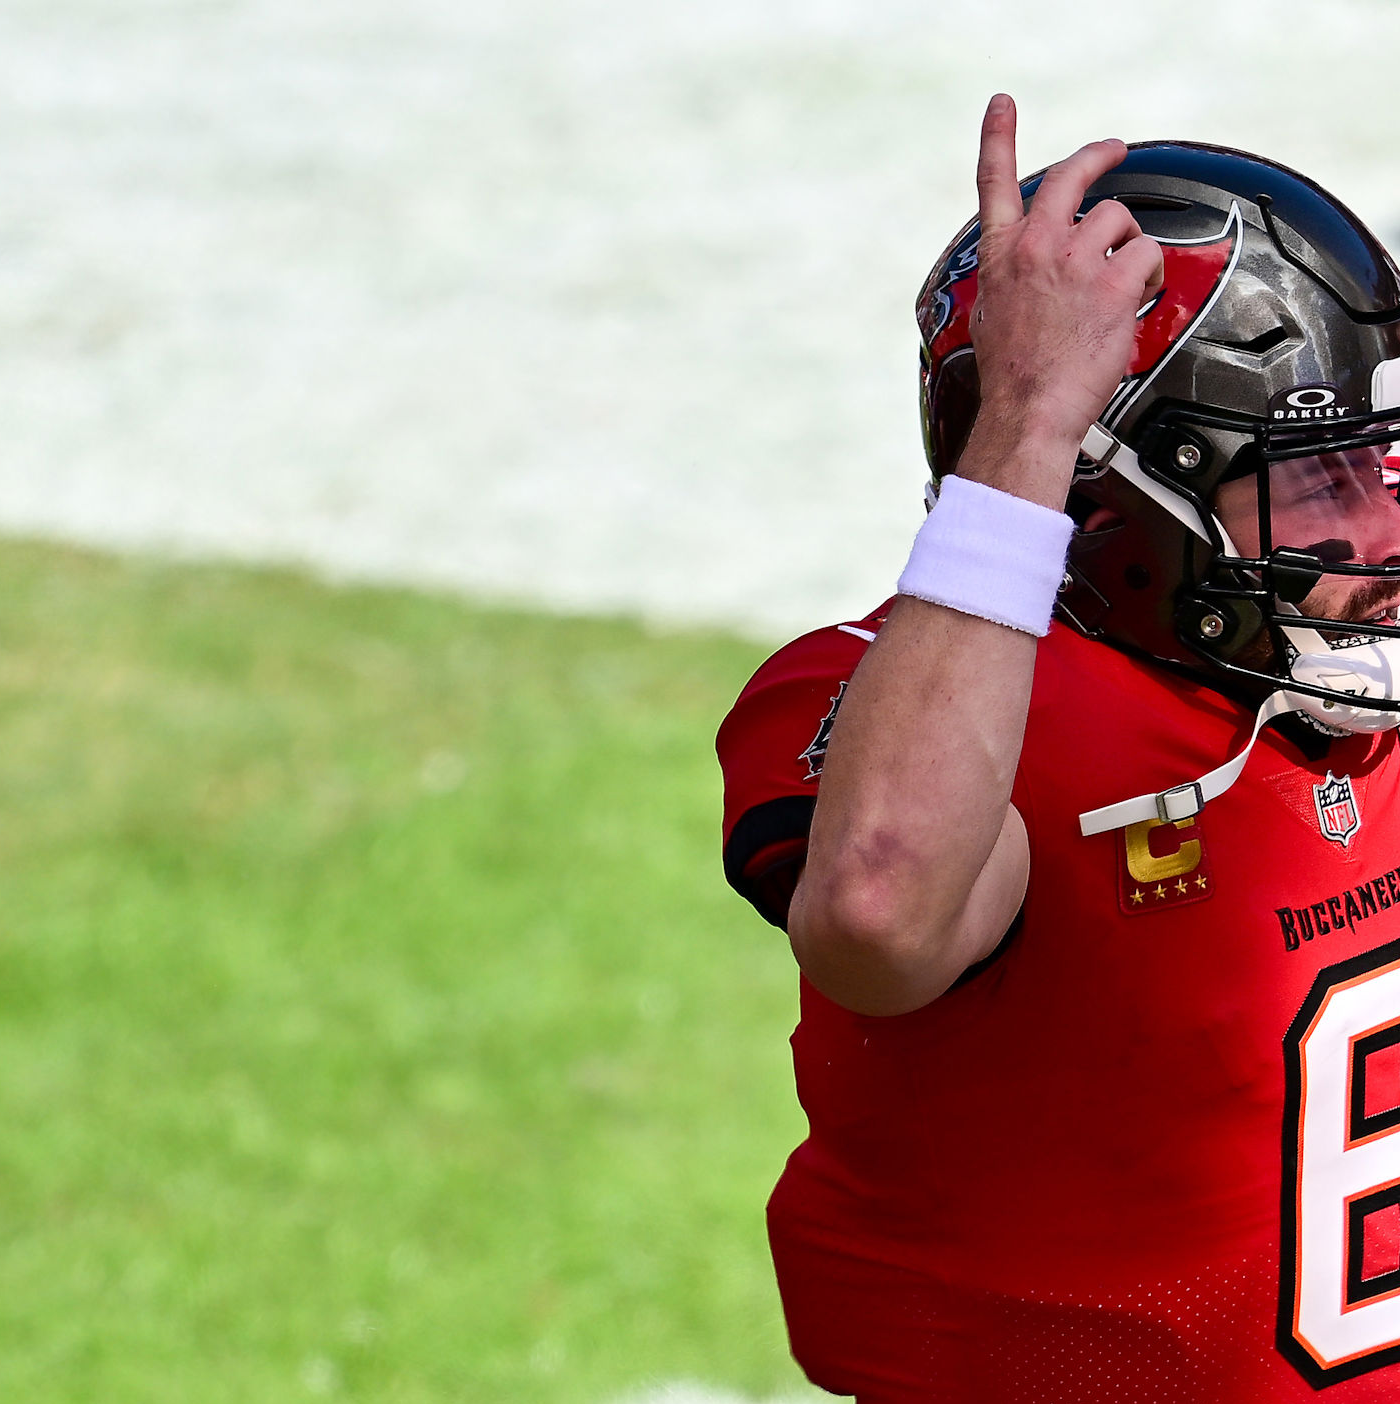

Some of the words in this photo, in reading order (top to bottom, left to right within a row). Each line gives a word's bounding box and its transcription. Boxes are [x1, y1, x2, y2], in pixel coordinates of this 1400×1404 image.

[1274, 407, 1346, 419] OAKLEY
[1325, 803, 1356, 832] NFL
[1124, 816, 1202, 884] C
